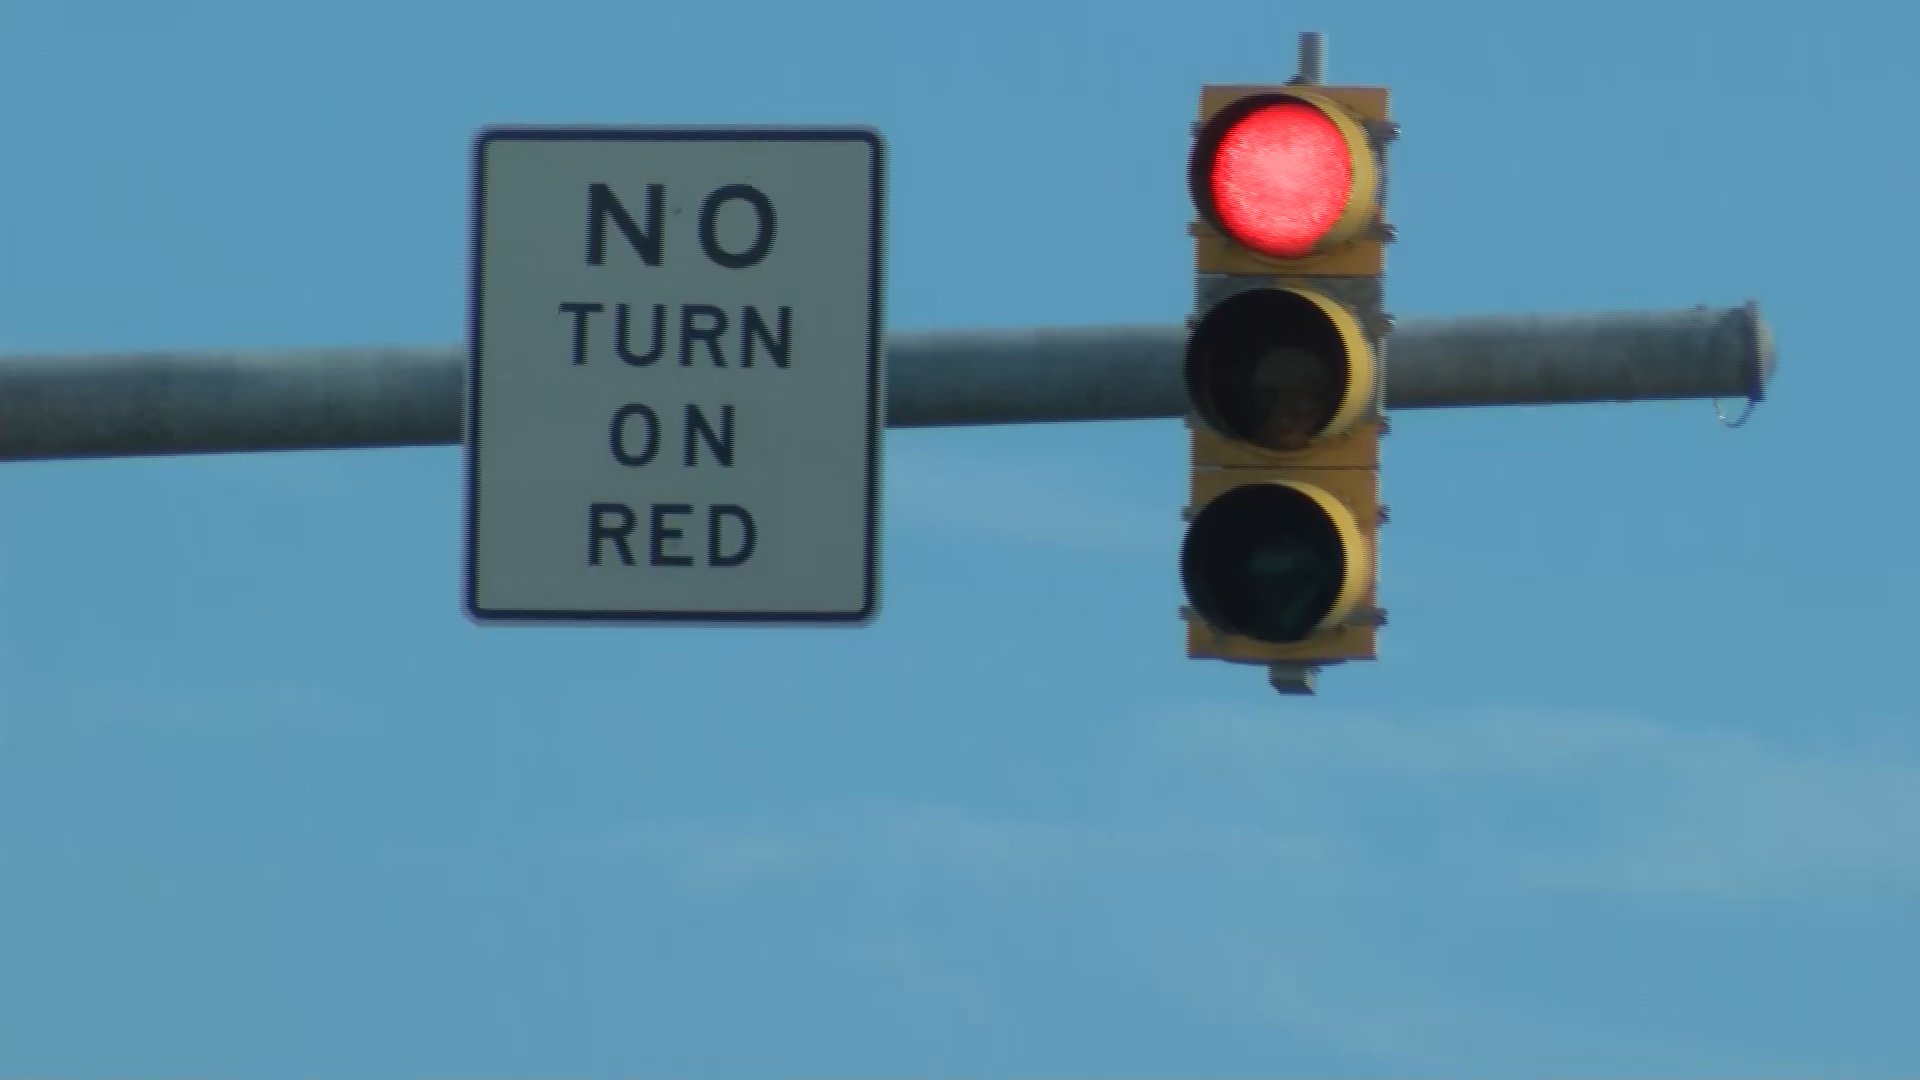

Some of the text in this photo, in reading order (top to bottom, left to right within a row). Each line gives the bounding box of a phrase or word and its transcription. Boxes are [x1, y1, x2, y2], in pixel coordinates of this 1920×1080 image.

[583, 181, 779, 270] NO
[557, 301, 794, 369] TURN
[607, 401, 737, 469] ON
[586, 501, 759, 569] RED
